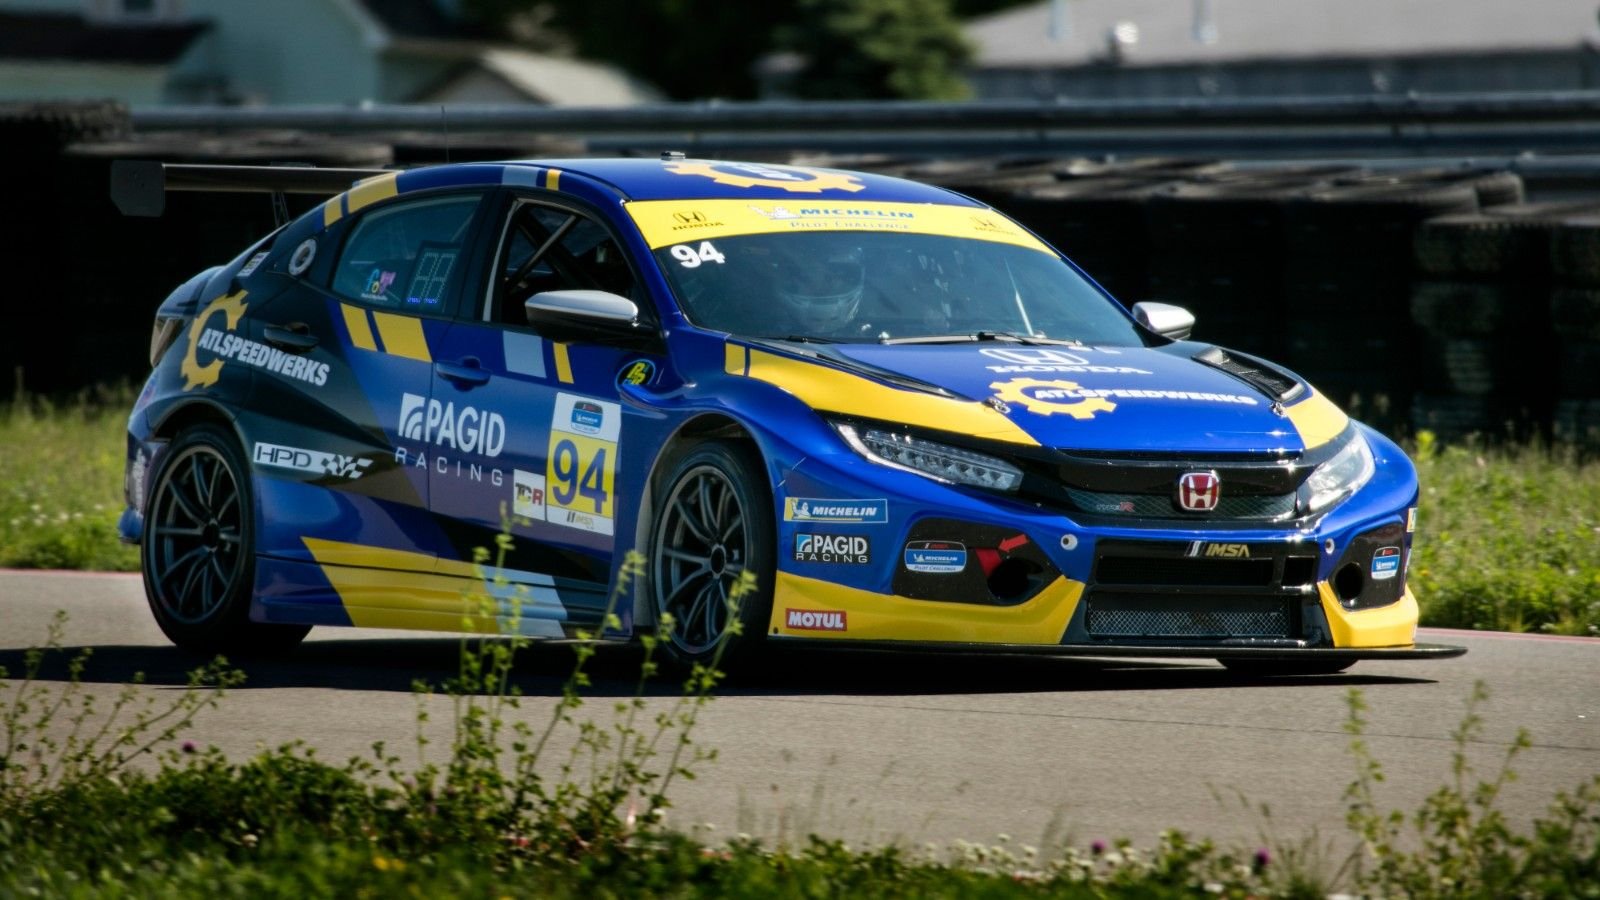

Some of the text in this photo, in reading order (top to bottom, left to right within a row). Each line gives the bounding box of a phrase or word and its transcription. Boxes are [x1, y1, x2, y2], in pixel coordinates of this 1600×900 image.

[800, 209, 914, 219] MICHELIN
[672, 222, 724, 231] HONDA
[670, 241, 725, 268] 94
[198, 328, 330, 386] ATLSPEEDWERKS
[985, 365, 1153, 375] HONDA
[1035, 388, 1258, 405] ATLSPEEDWERKS
[424, 399, 506, 457] PAGID
[256, 447, 312, 468] HPD
[395, 446, 503, 486] RACING
[552, 439, 607, 514] 94
[515, 482, 544, 505] TCR
[812, 505, 877, 517] MICHELIN
[813, 534, 868, 555] PAGID
[1205, 543, 1250, 558] IMSA
[796, 552, 868, 564] RACING
[788, 611, 844, 629] MOTUL
